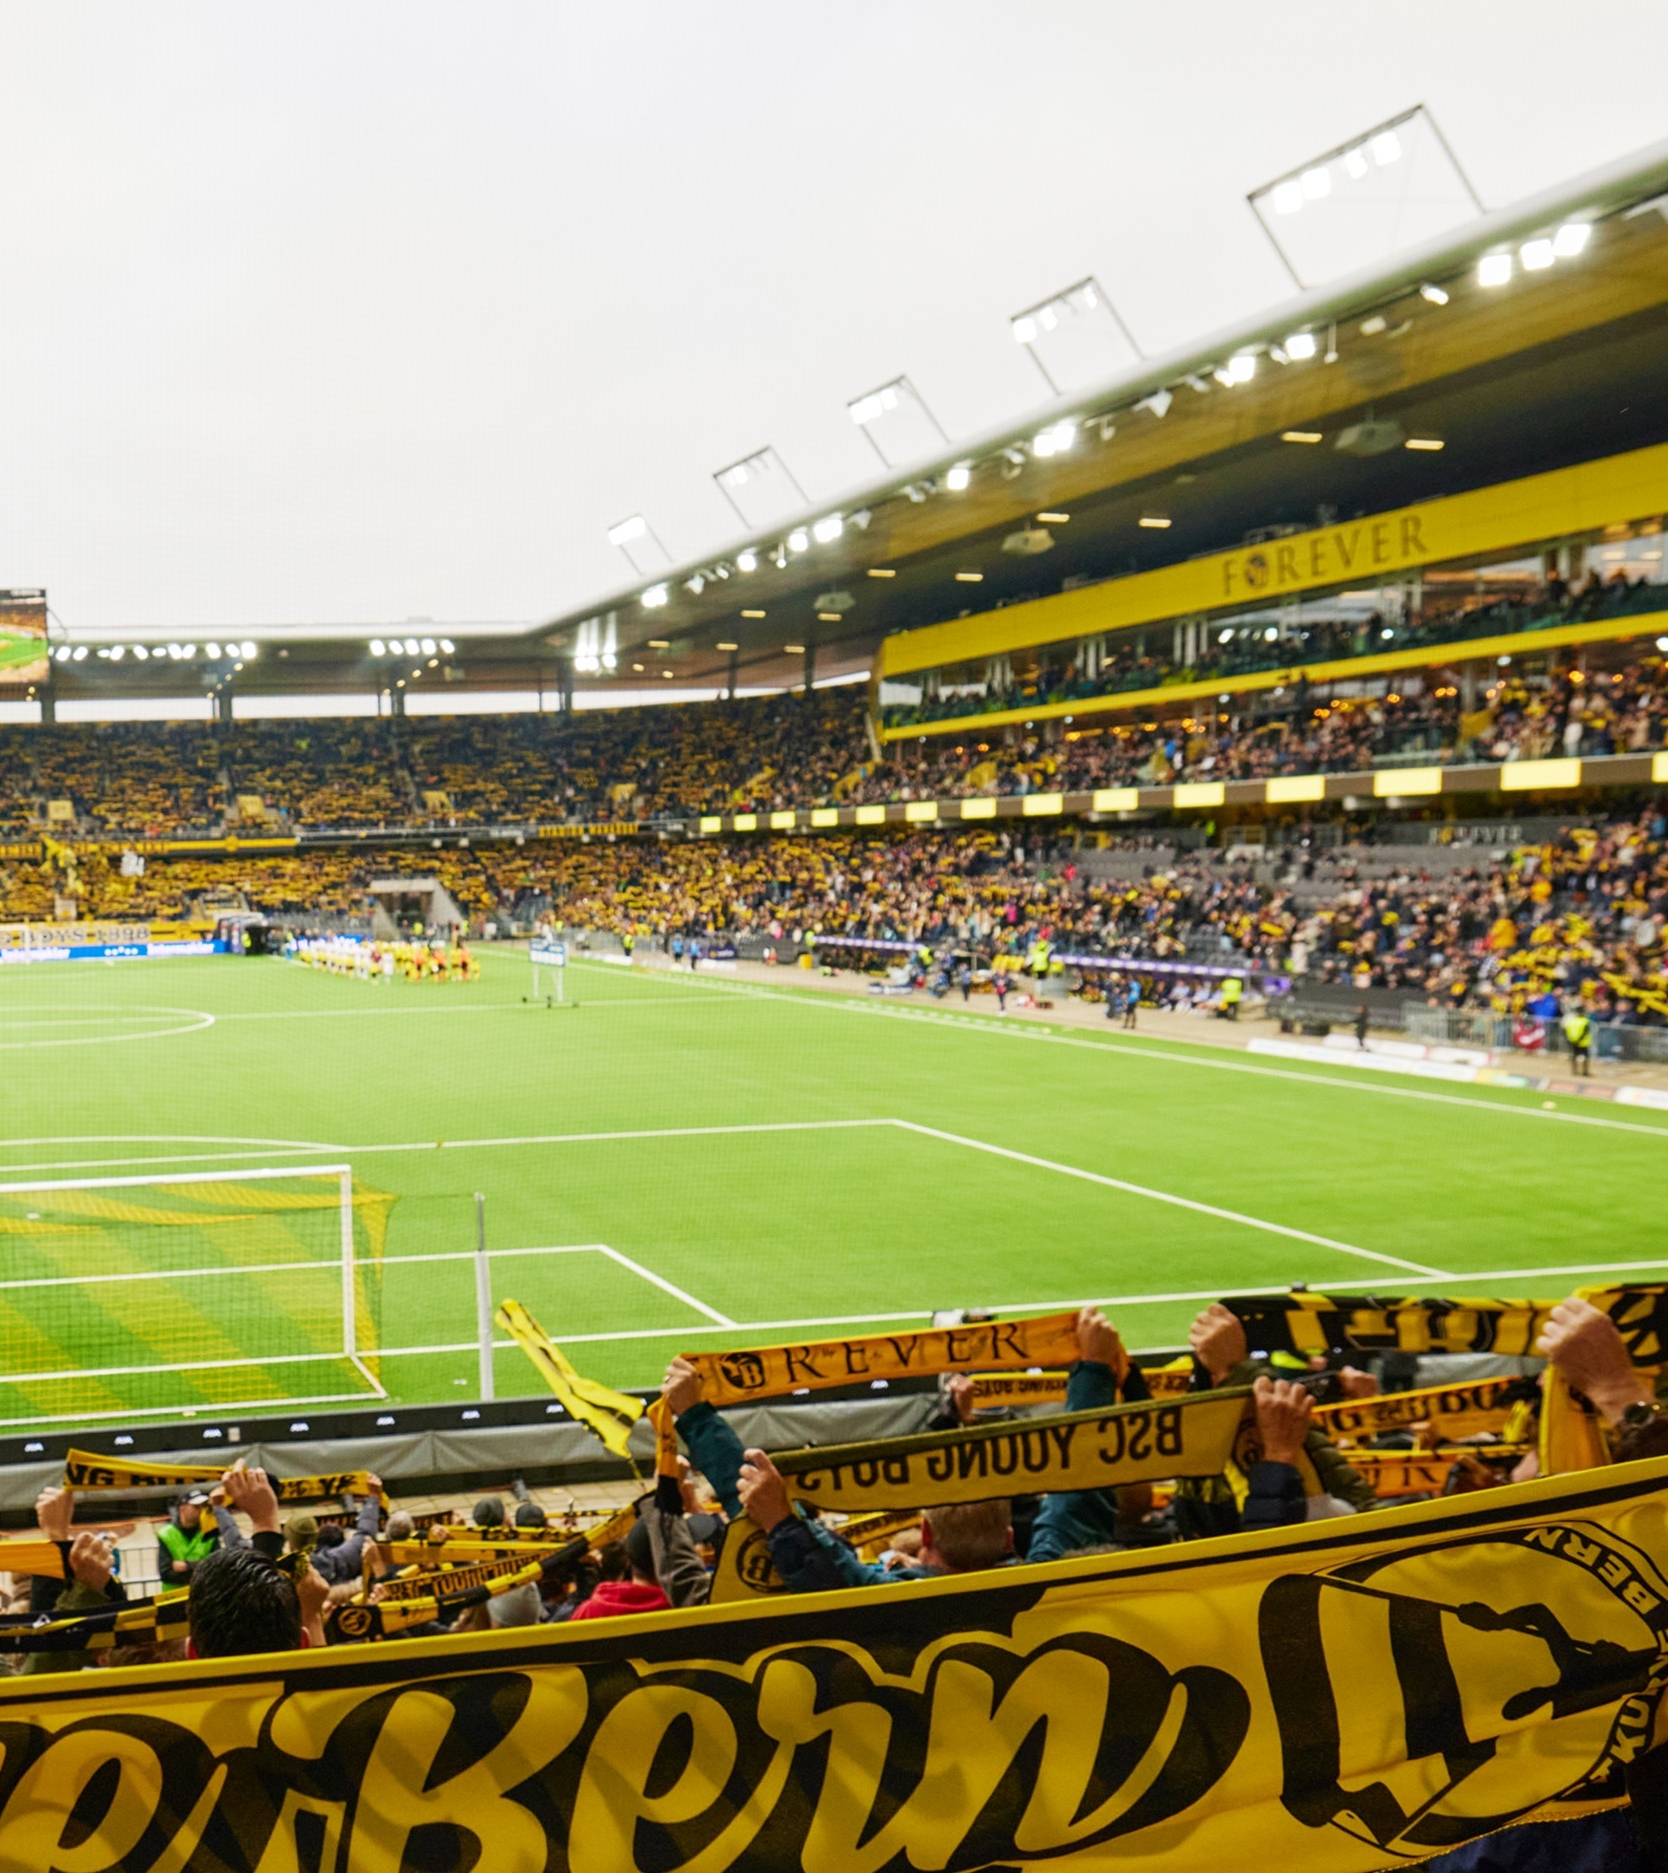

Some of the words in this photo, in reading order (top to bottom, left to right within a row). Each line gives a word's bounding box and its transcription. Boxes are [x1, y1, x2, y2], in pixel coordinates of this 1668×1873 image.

[1222, 514, 1429, 597] FOREVER
[1428, 824, 1524, 844] FEVER
[1523, 1526, 1661, 1615] BERN
[270, 1647, 1189, 1873] Bern
